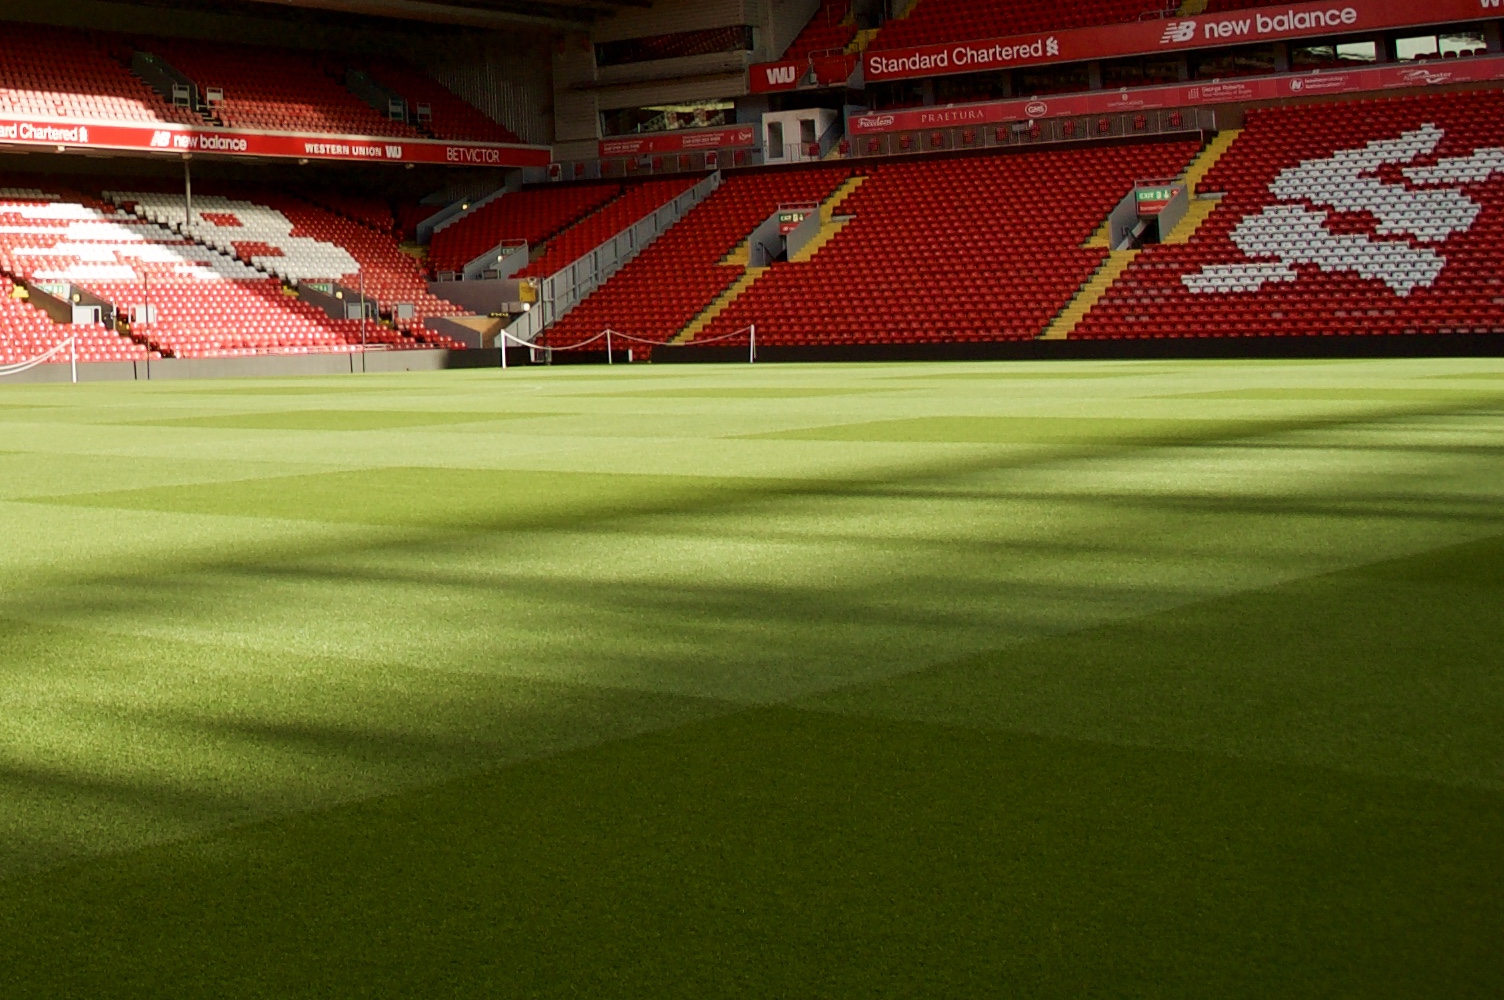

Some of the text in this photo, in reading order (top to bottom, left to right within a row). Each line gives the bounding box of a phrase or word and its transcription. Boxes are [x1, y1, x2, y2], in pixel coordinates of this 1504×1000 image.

[1205, 19, 1251, 39] new
[1256, 7, 1357, 33] balance
[870, 39, 1043, 74] Standard Chartered
[766, 66, 795, 85] WU
[921, 109, 984, 123] PRAETURA
[20, 122, 78, 141] Chartered
[174, 135, 199, 148] new
[200, 134, 247, 151] balance
[304, 143, 402, 158] WESTERN UNION WU
[446, 147, 500, 162] BETVICTOR
